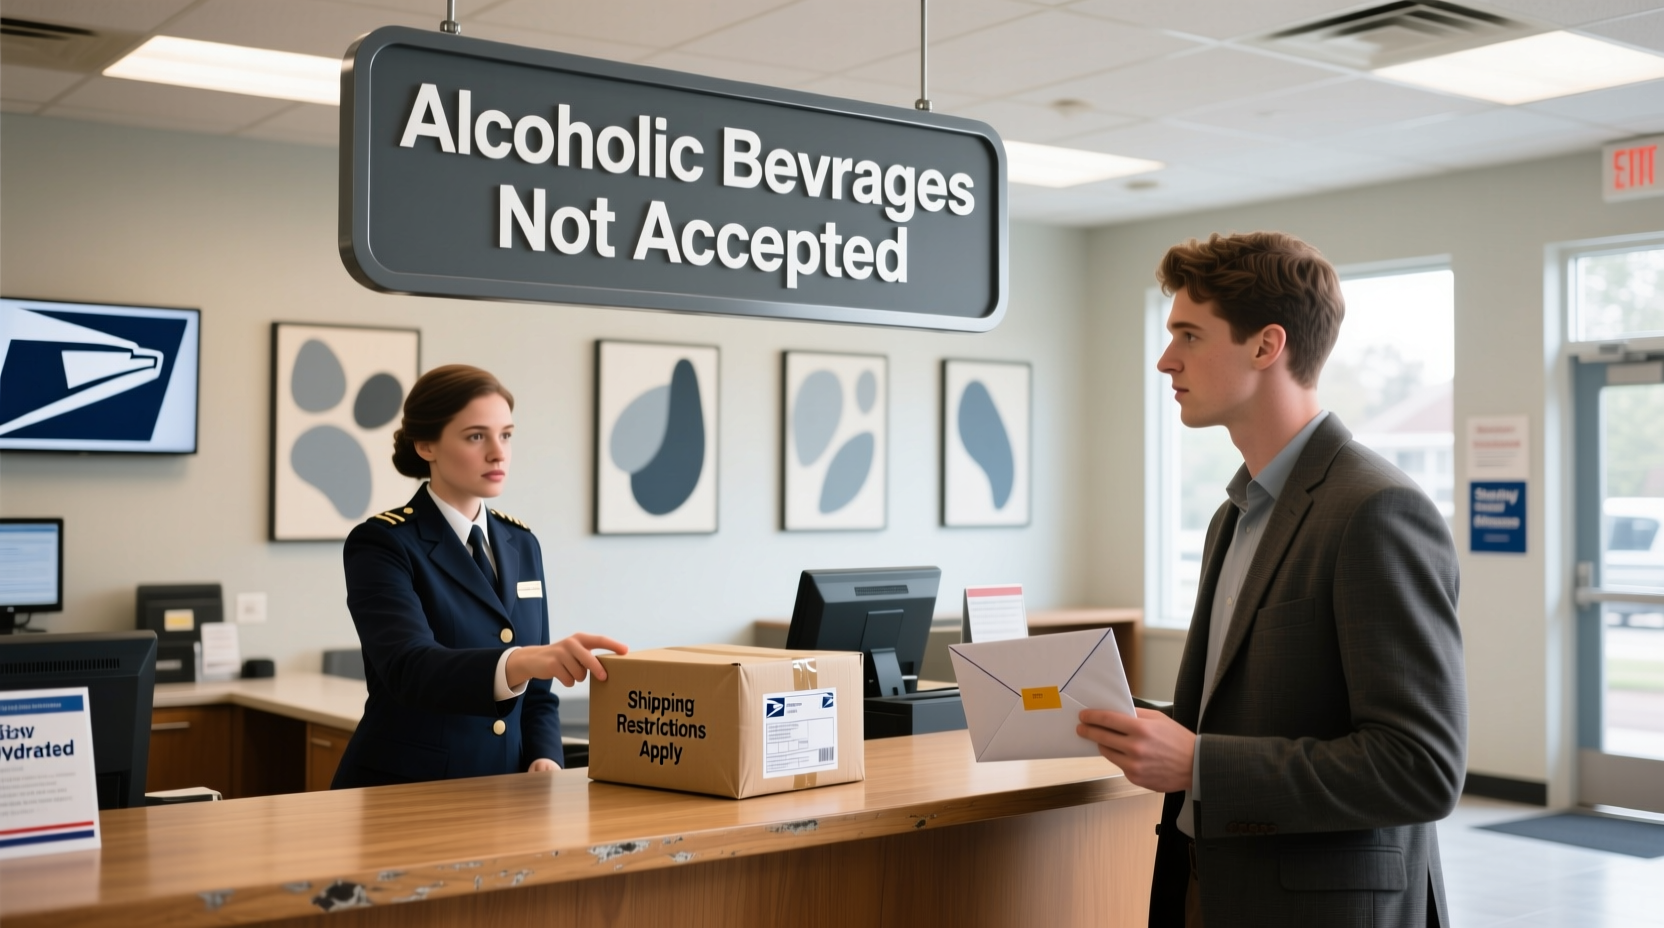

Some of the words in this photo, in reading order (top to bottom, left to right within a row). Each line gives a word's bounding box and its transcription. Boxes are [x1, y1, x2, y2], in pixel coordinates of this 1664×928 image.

[400, 83, 705, 183] Alcoholic
[722, 126, 975, 223] Bevrages
[498, 183, 616, 258] Not
[633, 200, 908, 289] Accepted
[627, 690, 695, 718] Shipping
[617, 713, 706, 740] Restrictions
[639, 740, 683, 766] Apply
